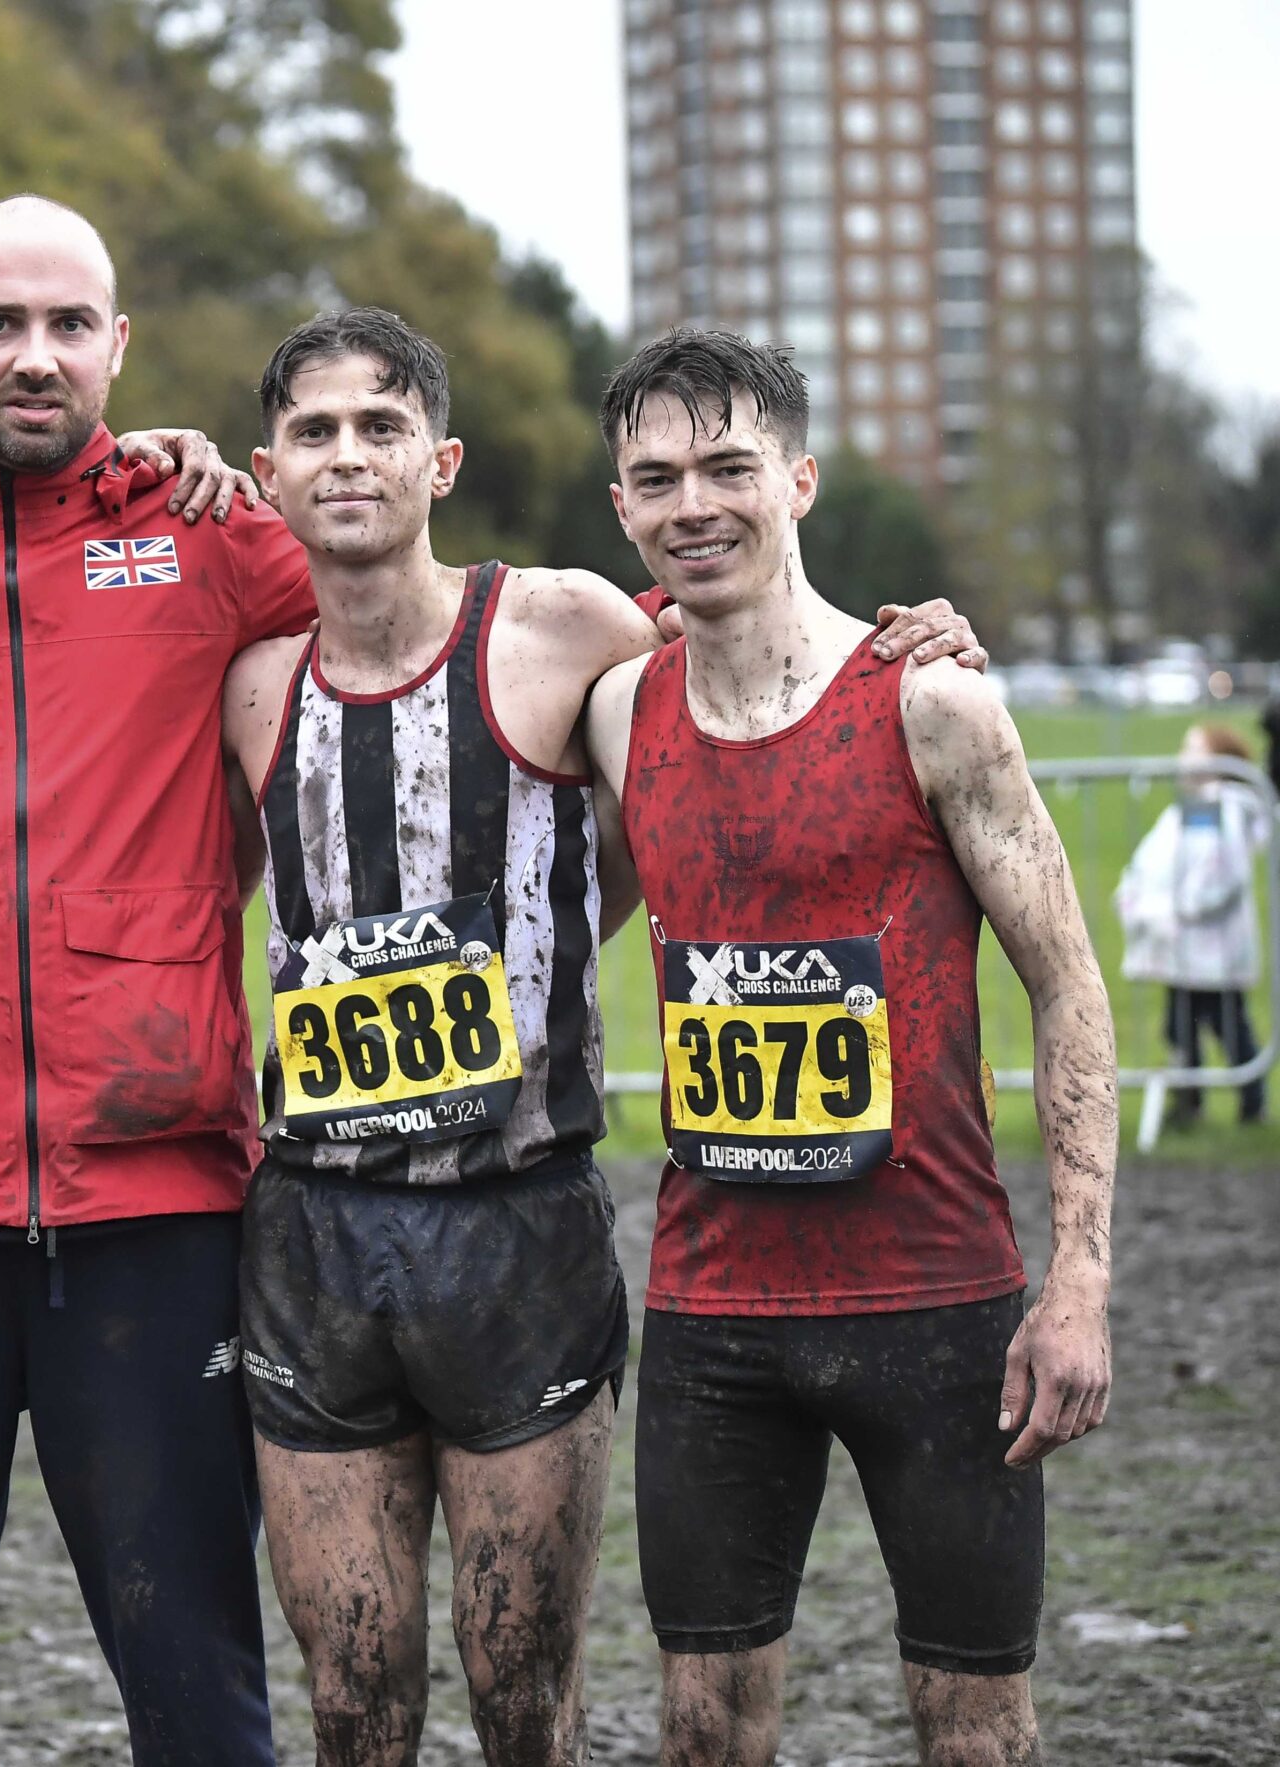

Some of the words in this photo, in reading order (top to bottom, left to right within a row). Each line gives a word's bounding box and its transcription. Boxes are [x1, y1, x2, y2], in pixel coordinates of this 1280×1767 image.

[345, 911, 455, 954] UKA
[350, 952, 389, 969] CROSS
[390, 936, 458, 961] CHALLENGE
[463, 949, 489, 964] U23
[734, 948, 841, 981] UKA
[736, 980, 771, 995] CROSS
[772, 977, 842, 994] CHALLENGE
[848, 995, 873, 1007] U23
[288, 973, 502, 1099] 3688
[678, 1017, 872, 1121] 3679
[242, 1358, 295, 1388] RMINGHAM
[244, 1349, 282, 1376] UNIVERTY
